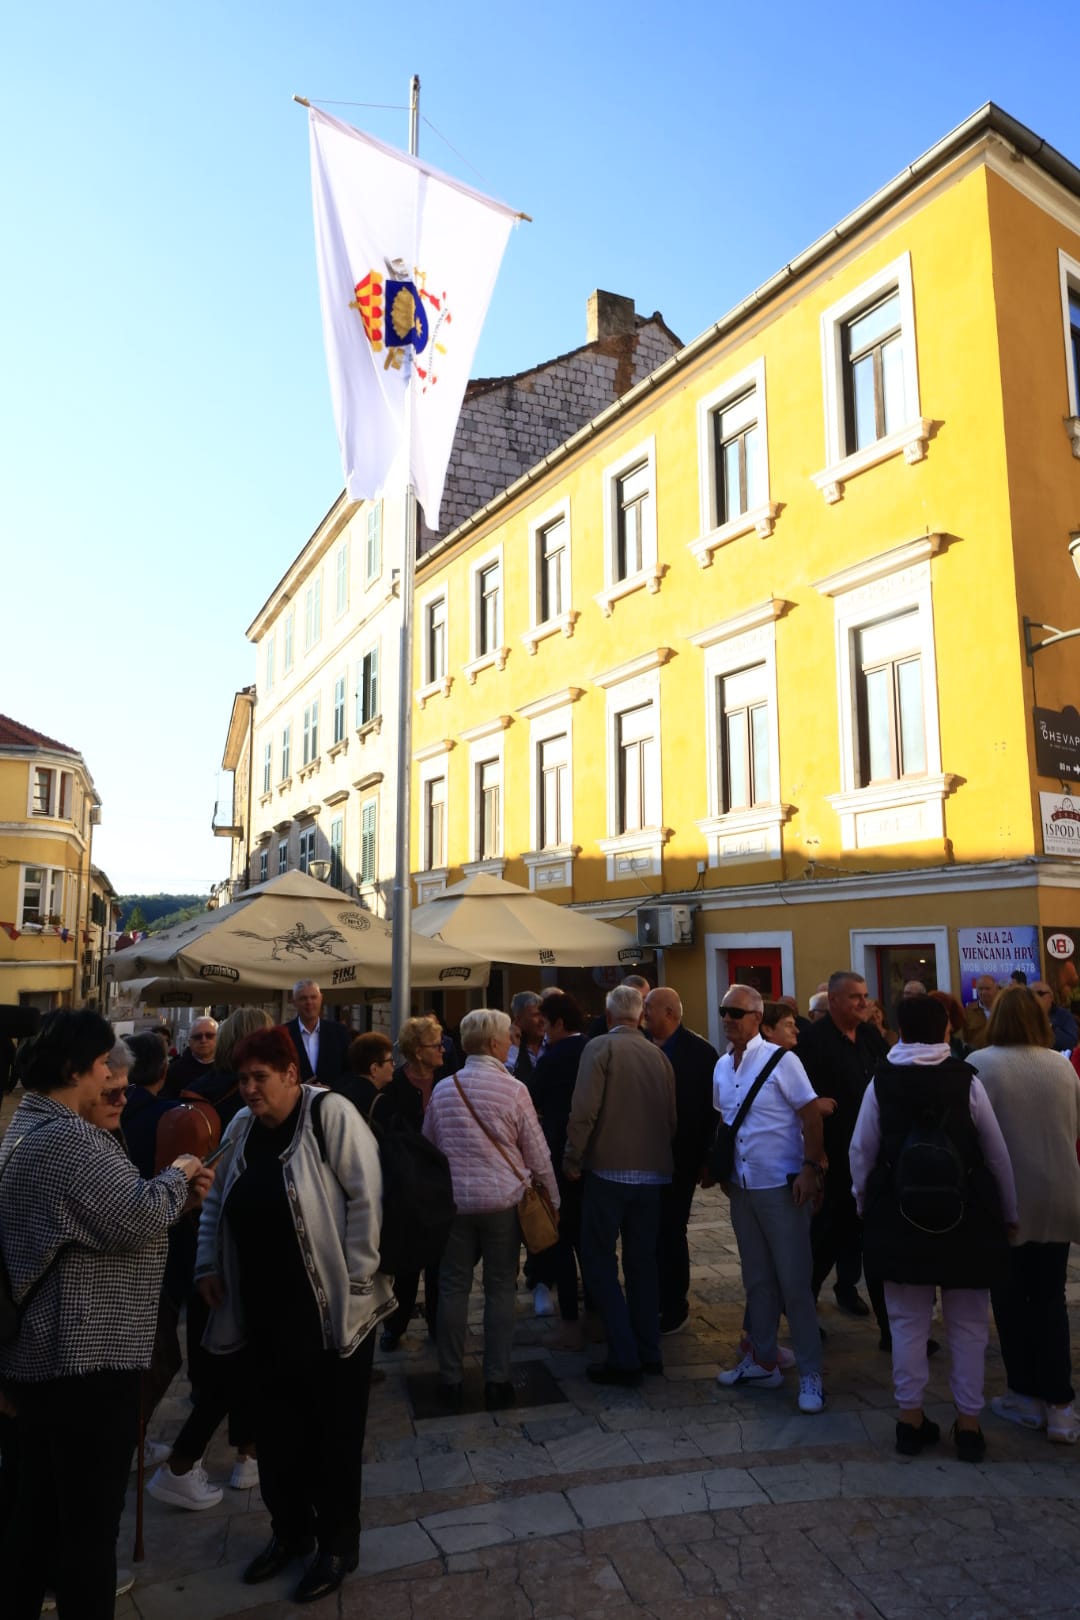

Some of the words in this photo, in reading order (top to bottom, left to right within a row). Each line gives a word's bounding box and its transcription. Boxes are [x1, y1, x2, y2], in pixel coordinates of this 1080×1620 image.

[1046, 823, 1074, 838] ISPOD
[976, 931, 999, 944] SALA
[1001, 931, 1014, 944] ZA
[1014, 946, 1034, 960] HRV
[333, 965, 356, 978] SINJ
